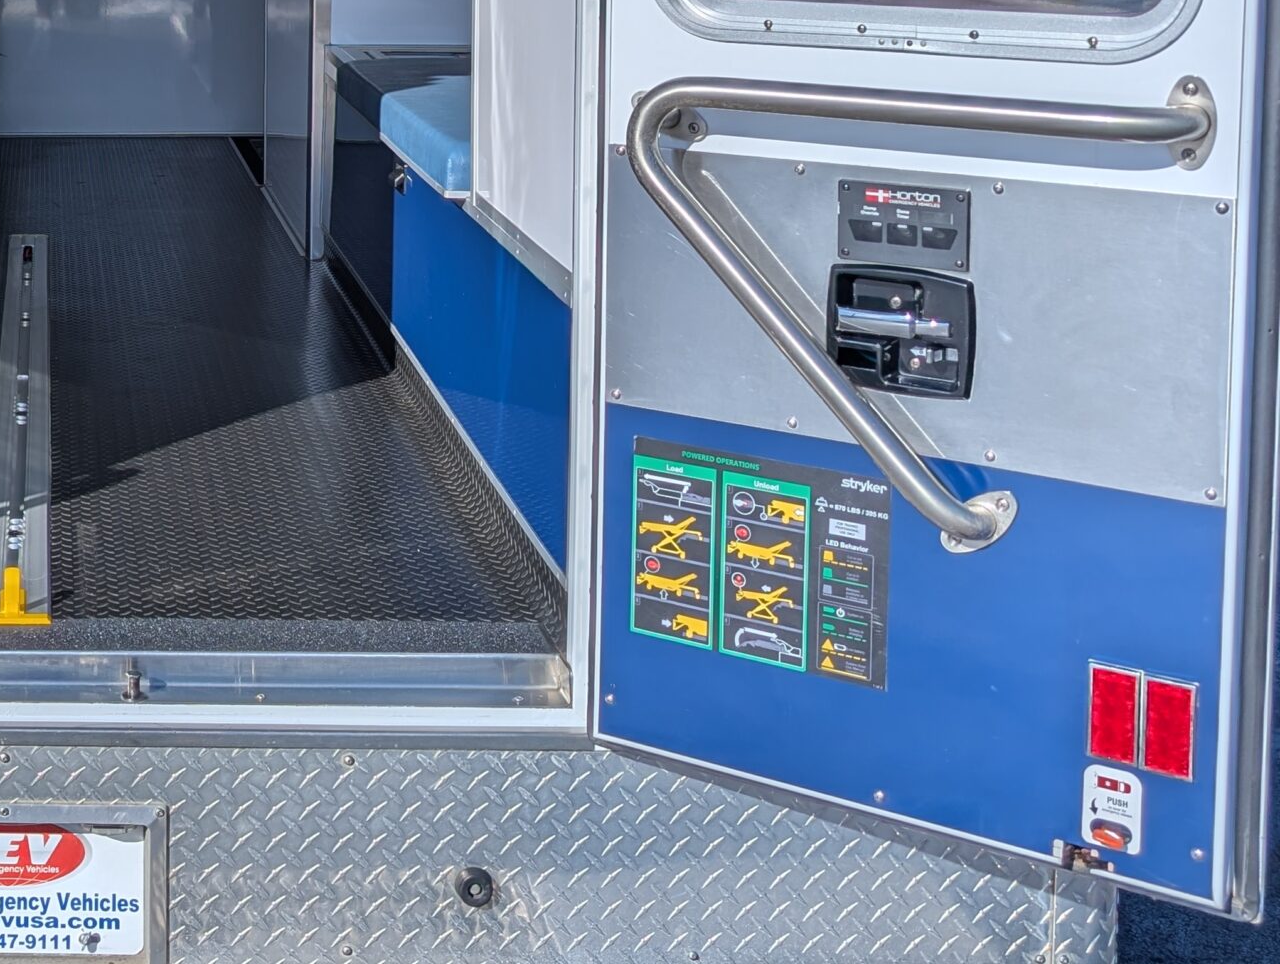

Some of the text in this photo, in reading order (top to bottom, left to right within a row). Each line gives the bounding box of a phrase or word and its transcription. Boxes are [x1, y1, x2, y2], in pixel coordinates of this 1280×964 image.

[888, 190, 940, 203] Horton
[682, 450, 760, 471] POWERED OPERATIONS
[666, 464, 684, 473] Load
[753, 480, 779, 491] Unload
[841, 477, 888, 494] stryker
[878, 512, 889, 520] KG
[825, 539, 869, 552] LED Behavior
[1107, 796, 1128, 808] PUSH
[26, 865, 59, 873] Vehicles
[56, 892, 139, 912] Vehicles
